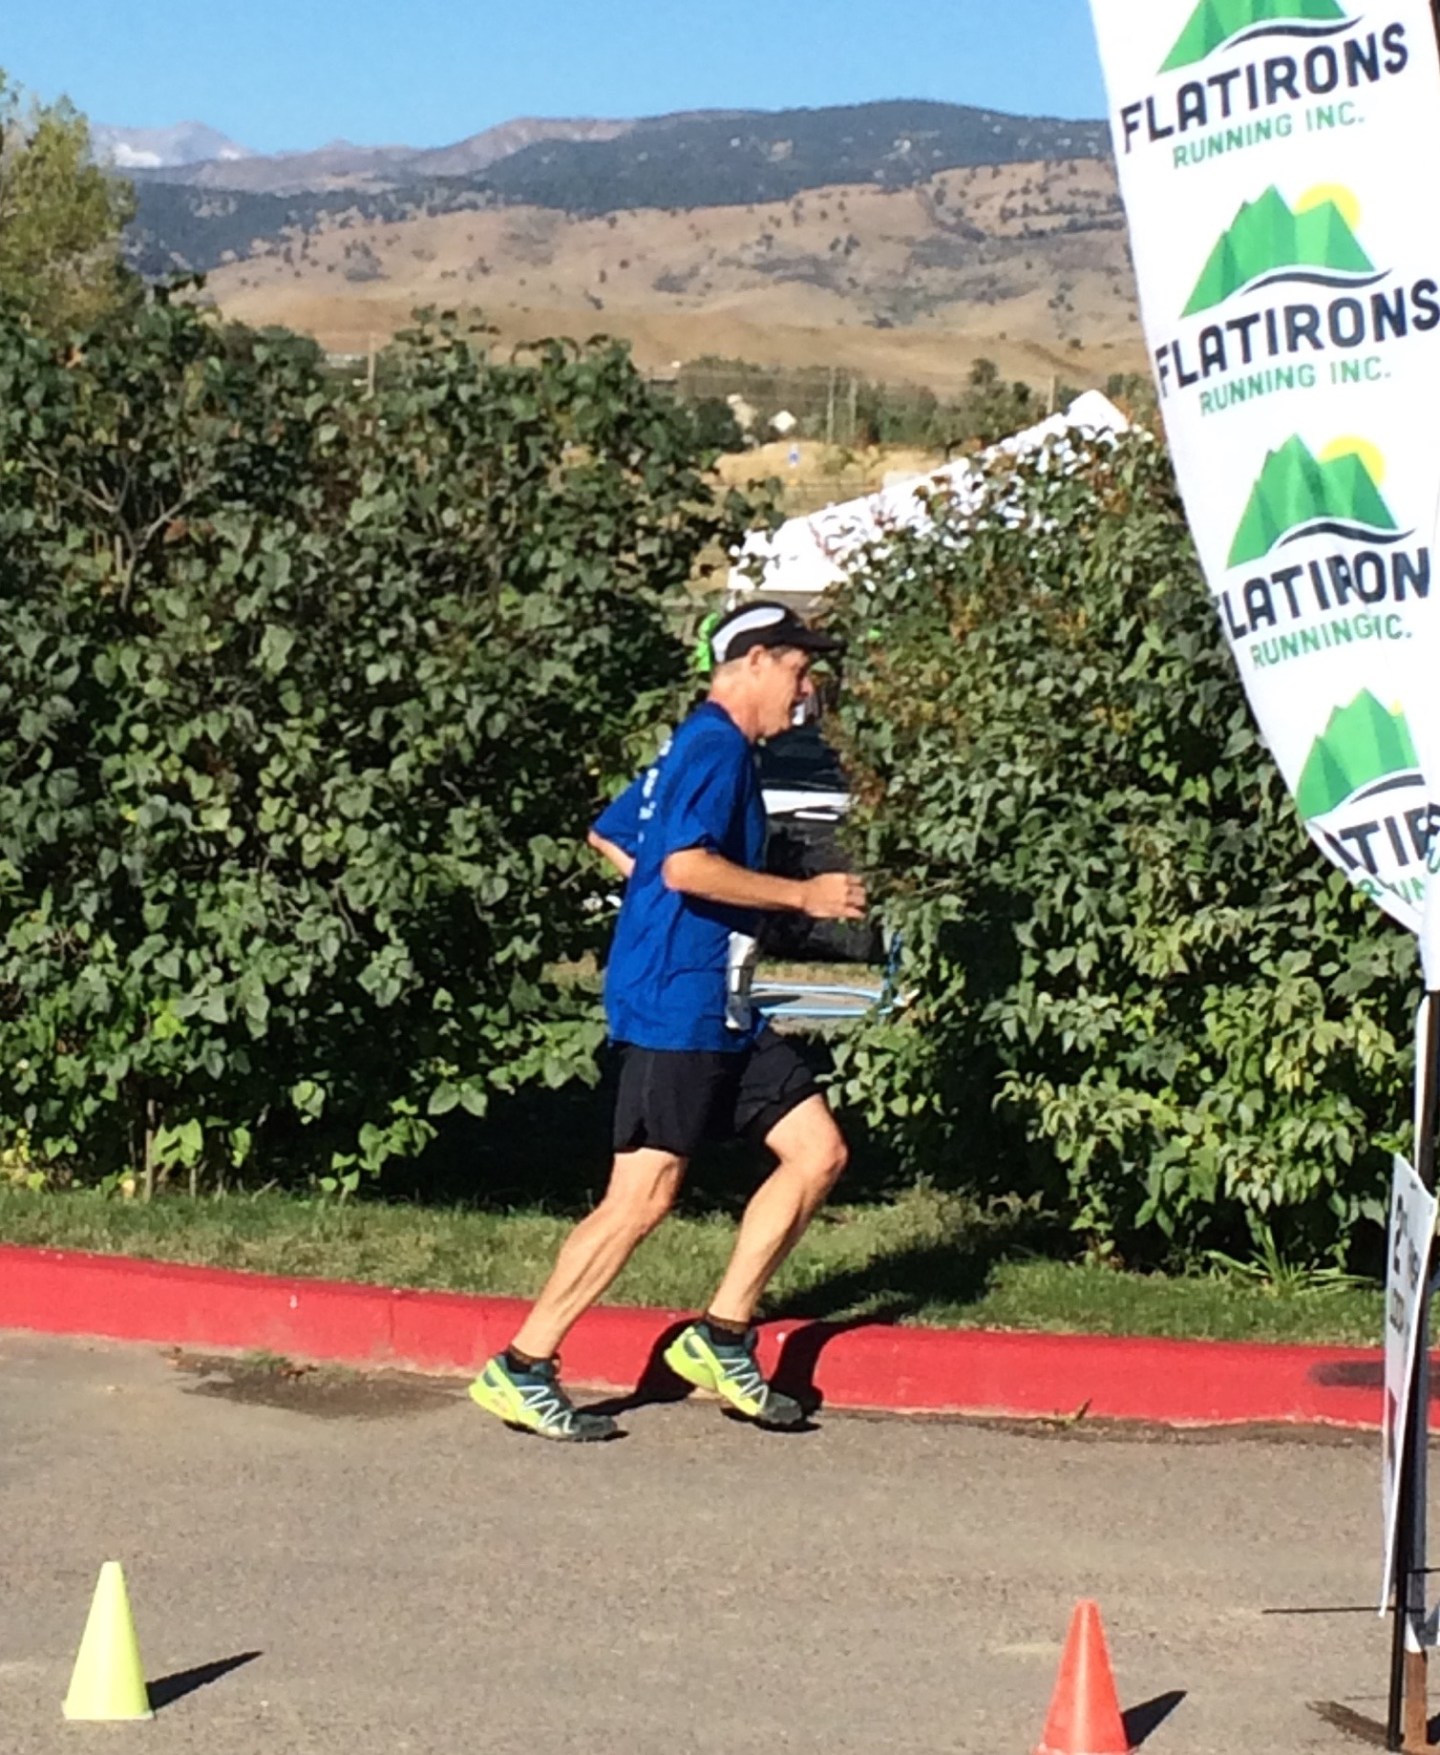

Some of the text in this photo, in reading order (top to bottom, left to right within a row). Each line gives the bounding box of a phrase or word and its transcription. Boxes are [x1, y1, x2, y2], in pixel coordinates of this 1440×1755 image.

[1119, 22, 1409, 155] FLATIRONS
[1172, 100, 1366, 170] RUNNING INC.
[1154, 278, 1440, 399] FLATIRONS
[1198, 355, 1392, 416] RUNNING INC.
